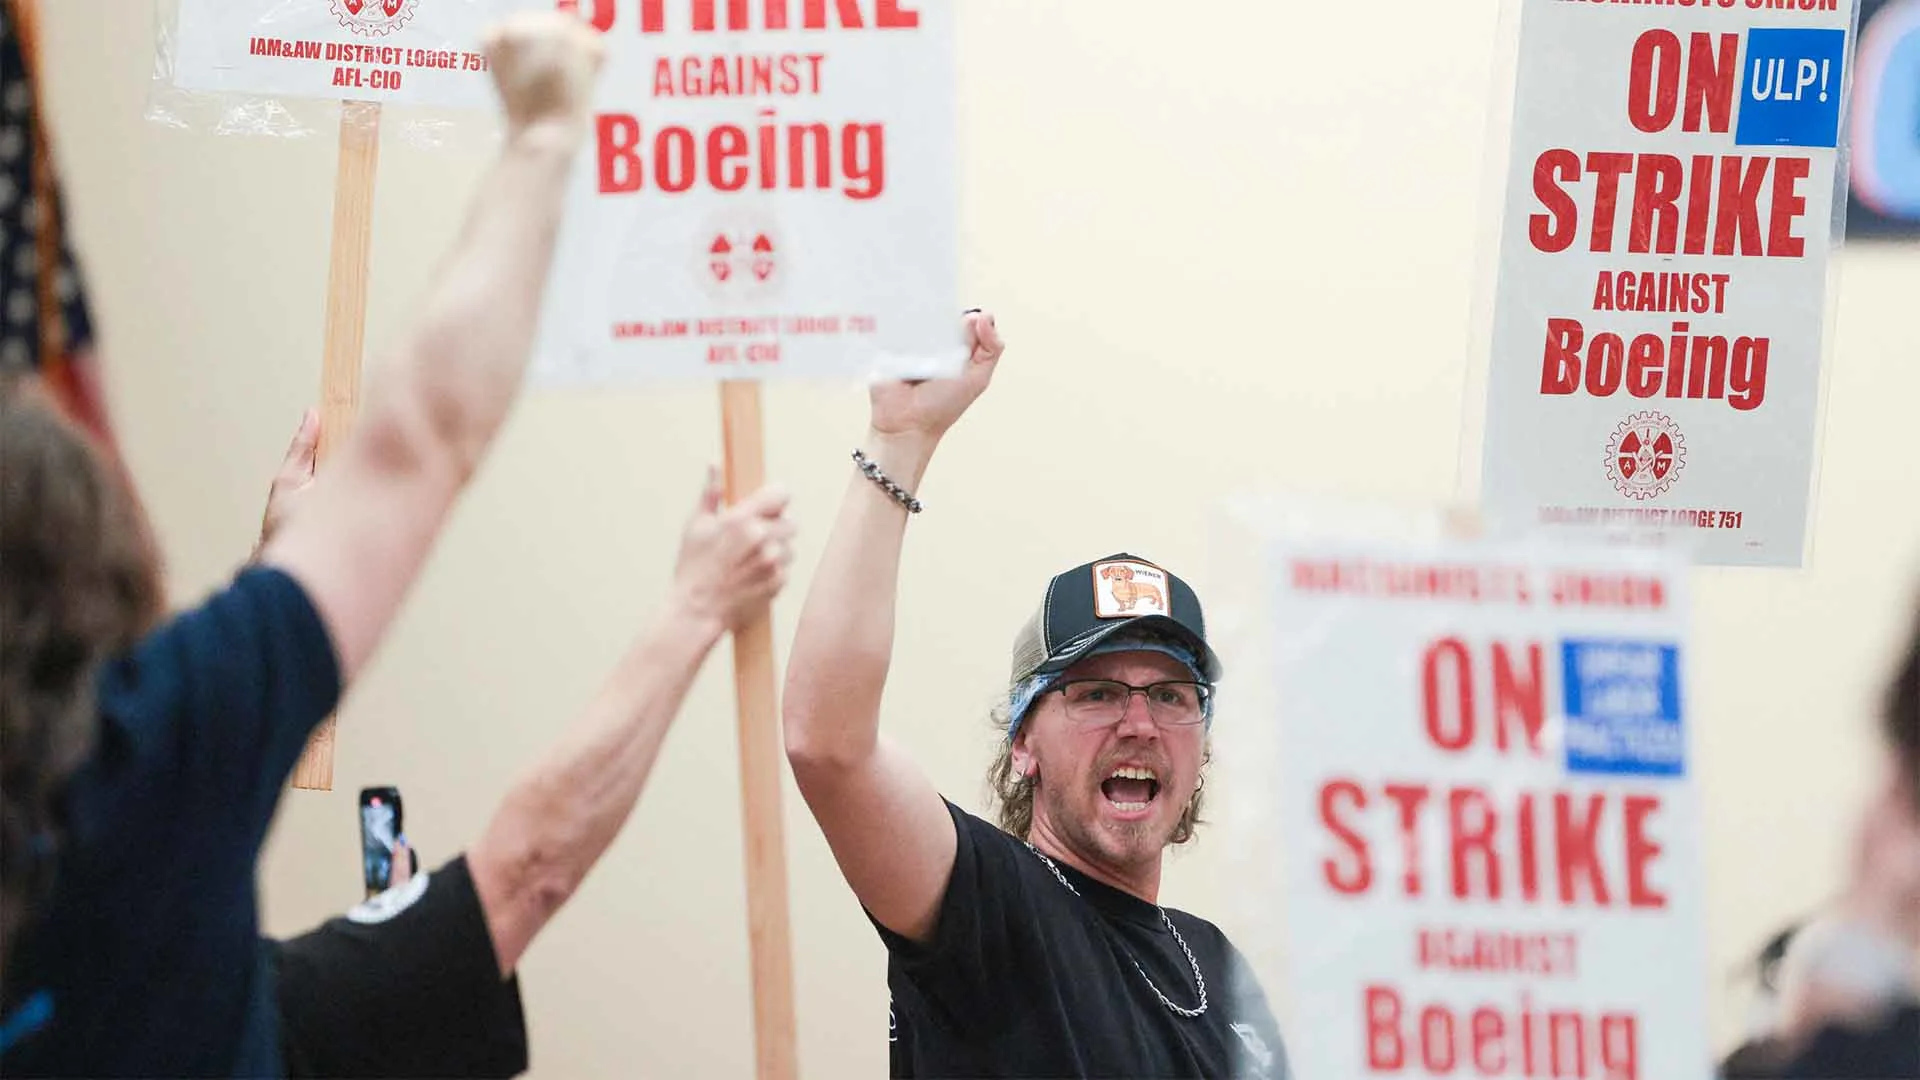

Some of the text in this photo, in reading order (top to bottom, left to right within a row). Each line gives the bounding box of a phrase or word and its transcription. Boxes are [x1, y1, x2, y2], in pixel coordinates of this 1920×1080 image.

[250, 37, 322, 60] IAM&AW
[326, 43, 401, 65] DISTRICT
[406, 50, 457, 69] LODGE
[332, 67, 401, 90] AFL-CIO
[653, 53, 825, 97] AGAINST
[1628, 28, 1739, 134] ON
[1751, 58, 1831, 102] ULP!
[593, 109, 886, 200] Boeing
[1528, 149, 1810, 257] STRIKE
[1593, 271, 1729, 314] AGAINST
[1540, 318, 1769, 411] Boeing
[1718, 511, 1743, 528] 751
[1421, 636, 1546, 753] ON
[1317, 779, 1667, 909] STRIKE
[1364, 985, 1638, 1080] Boeing
